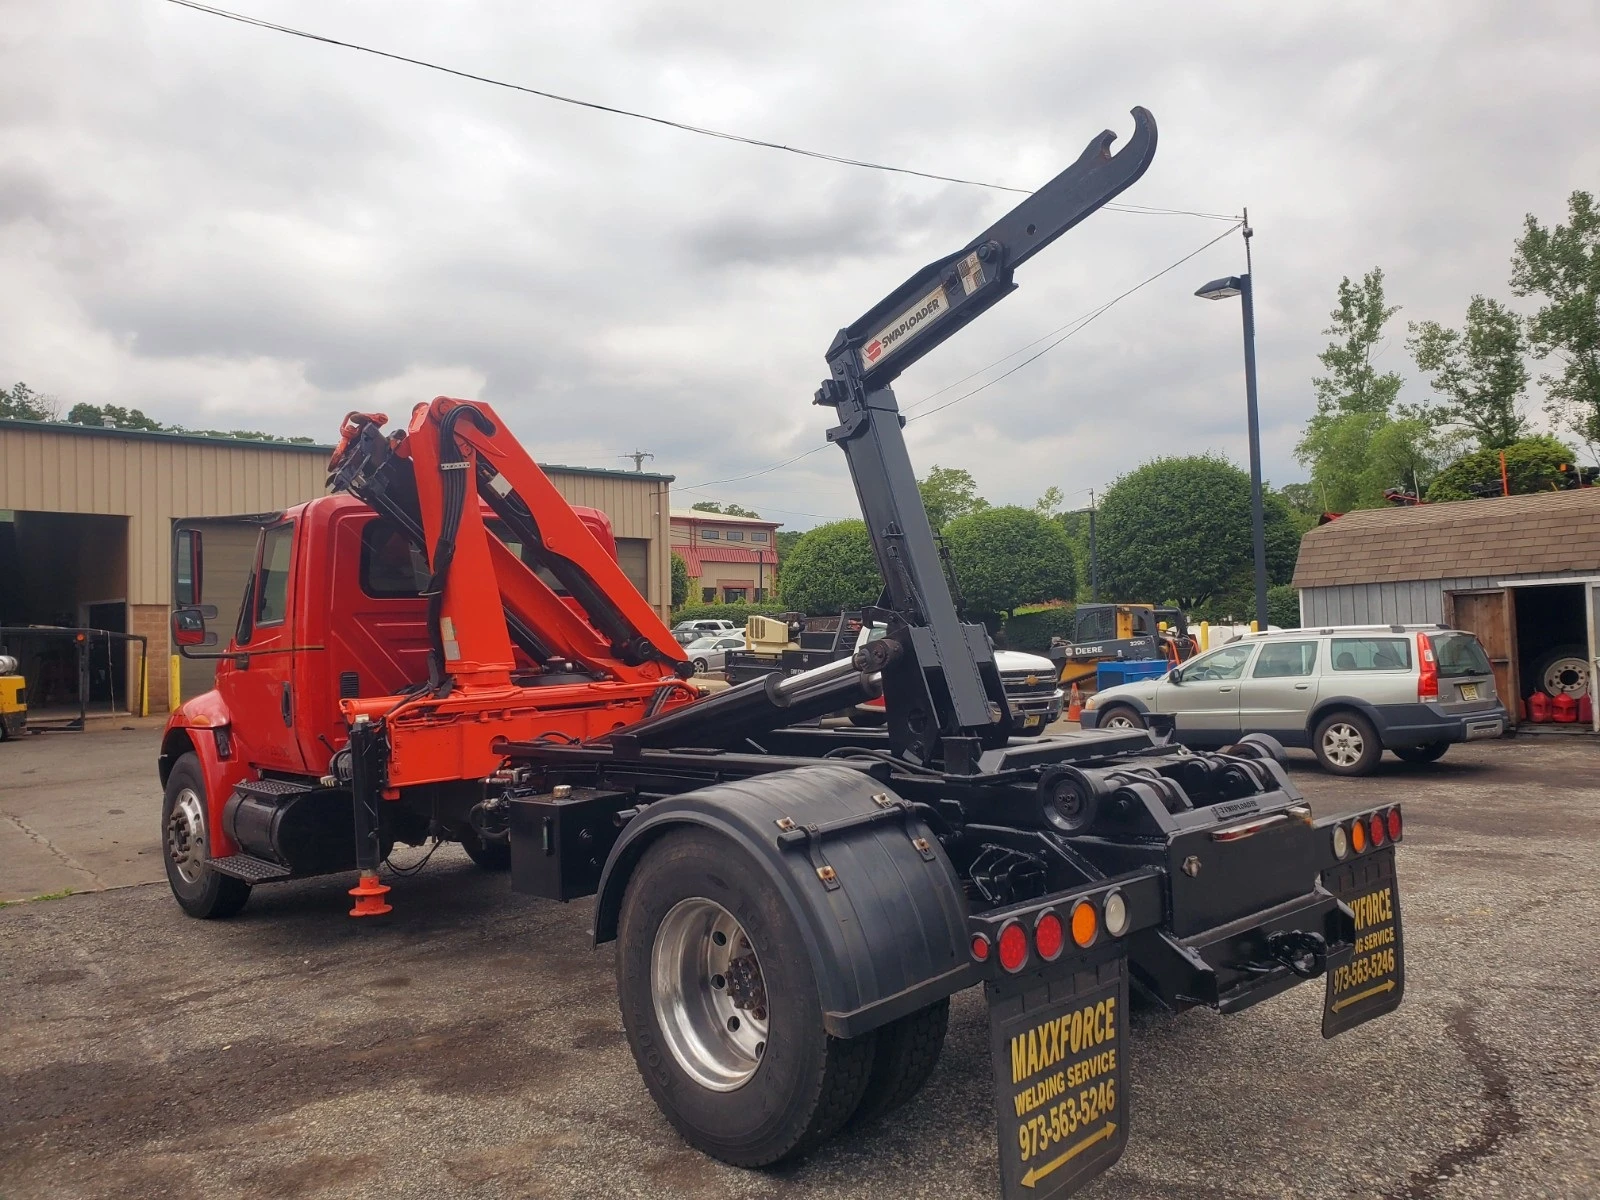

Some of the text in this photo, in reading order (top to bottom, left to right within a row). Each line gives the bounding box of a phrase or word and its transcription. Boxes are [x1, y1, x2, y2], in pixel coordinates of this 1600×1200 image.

[881, 298, 940, 349] SWAPLOADER
[1075, 645, 1104, 656] DEERE
[1364, 926, 1395, 952] SERVICE
[1333, 947, 1396, 996] 973-563-5246
[1011, 996, 1116, 1085] MAXXFORCE
[1013, 1048, 1117, 1118] WELDING SERVICE
[1019, 1078, 1116, 1163] 973-563-5246
